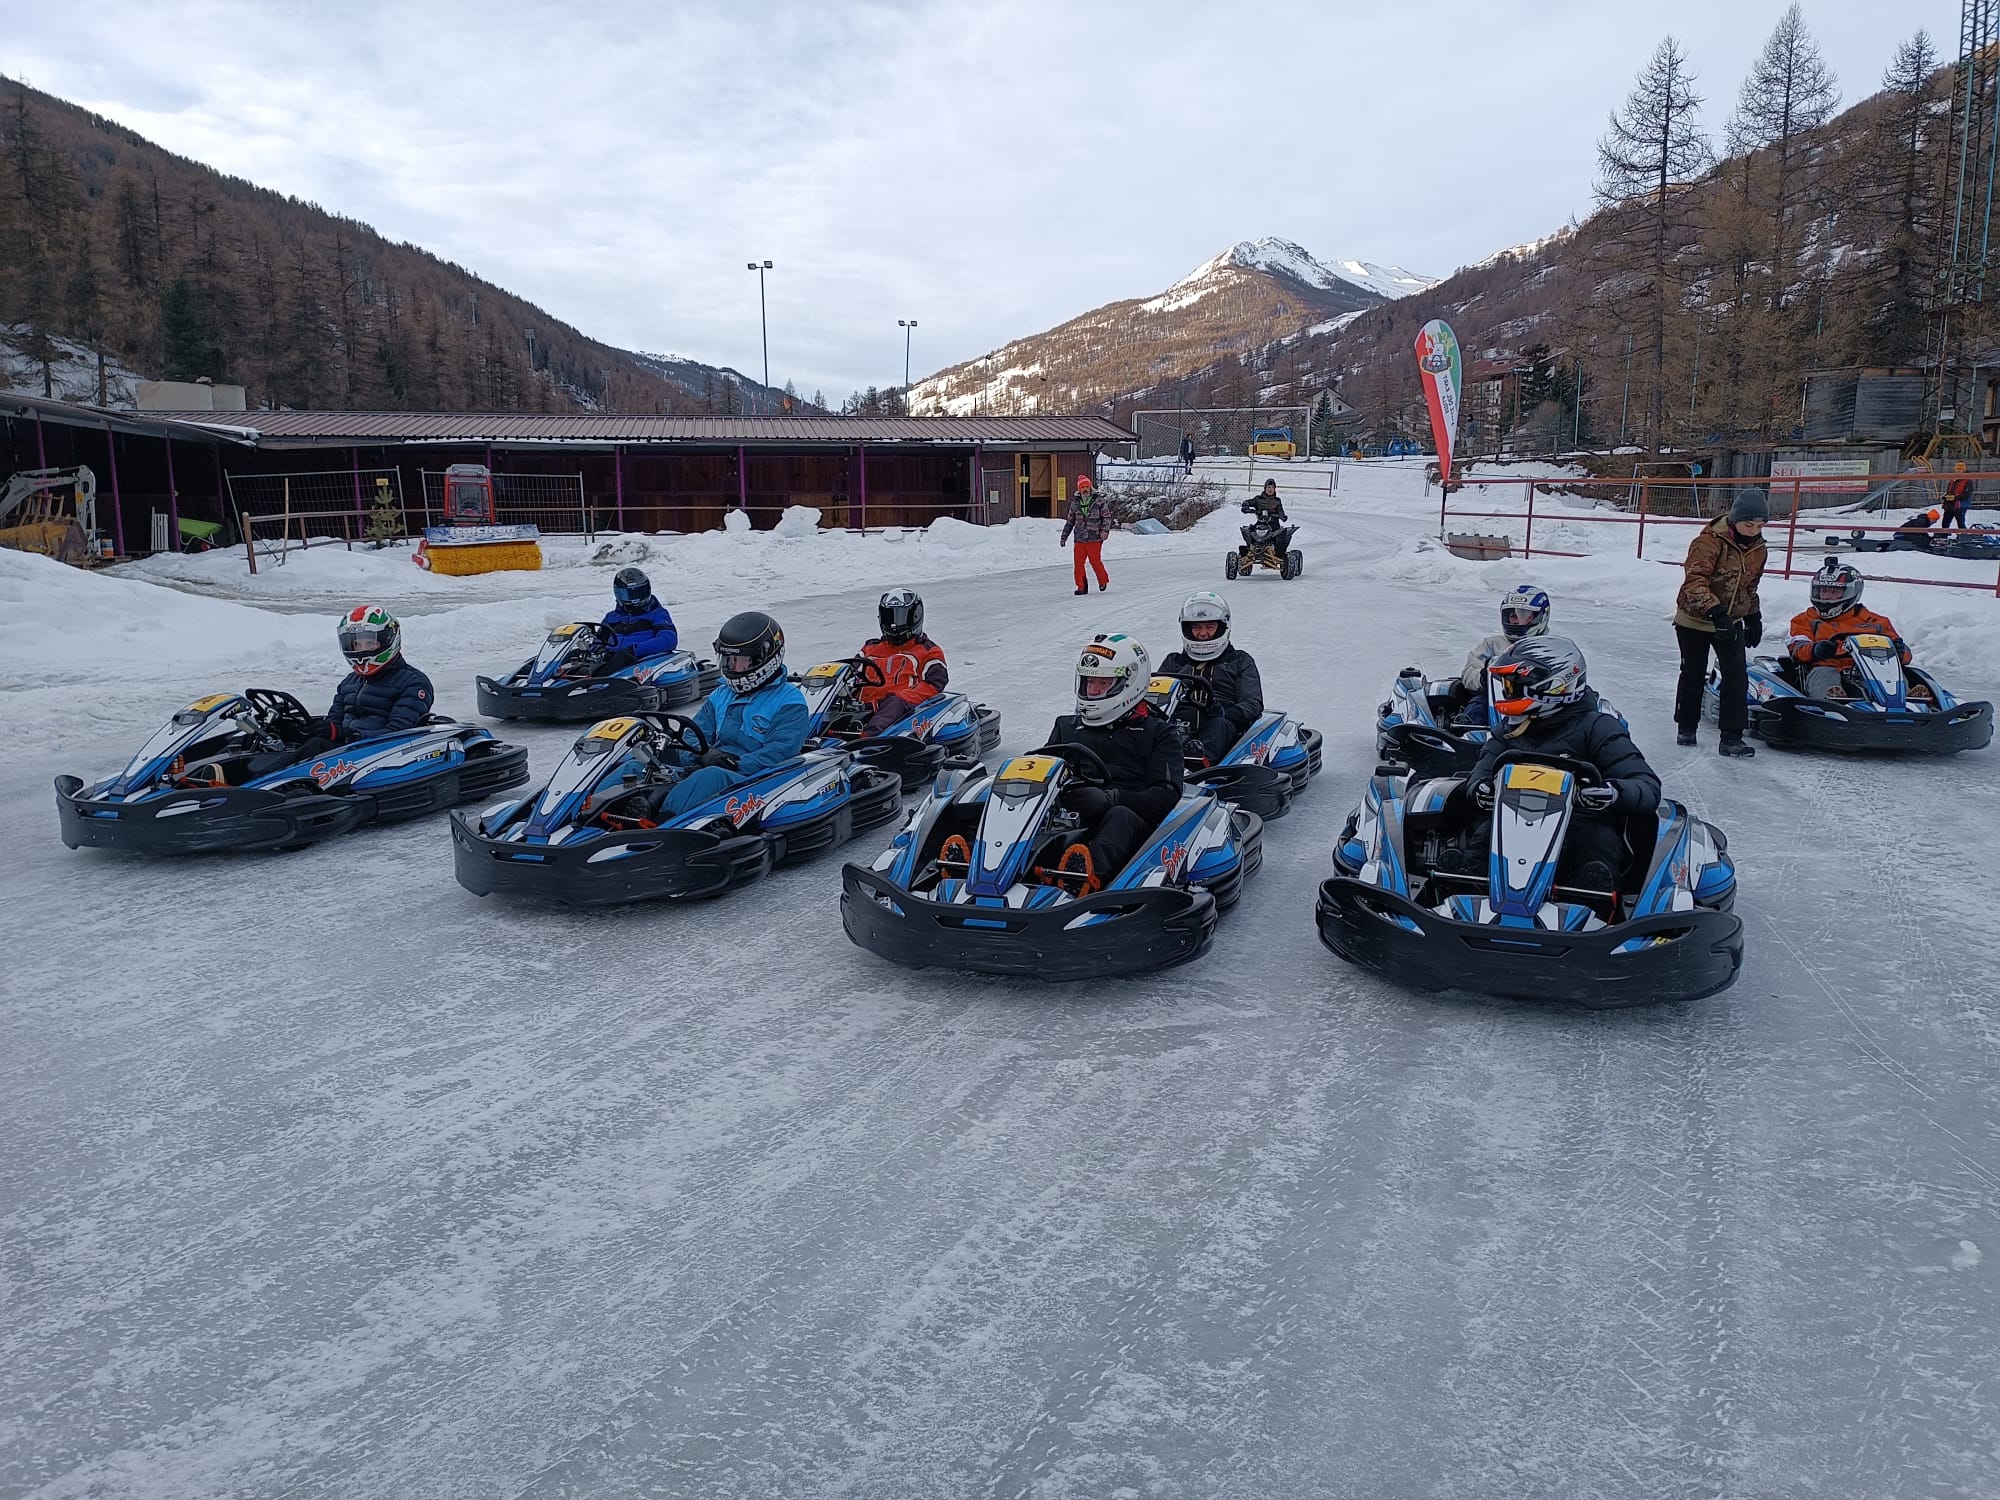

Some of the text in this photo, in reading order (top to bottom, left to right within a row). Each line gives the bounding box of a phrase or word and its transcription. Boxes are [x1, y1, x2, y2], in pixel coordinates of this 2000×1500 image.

[598, 722, 624, 733] 10
[310, 758, 359, 787] Sodi
[1018, 760, 1036, 772] 3
[1528, 769, 1547, 782] 7
[724, 792, 768, 826] Sodi
